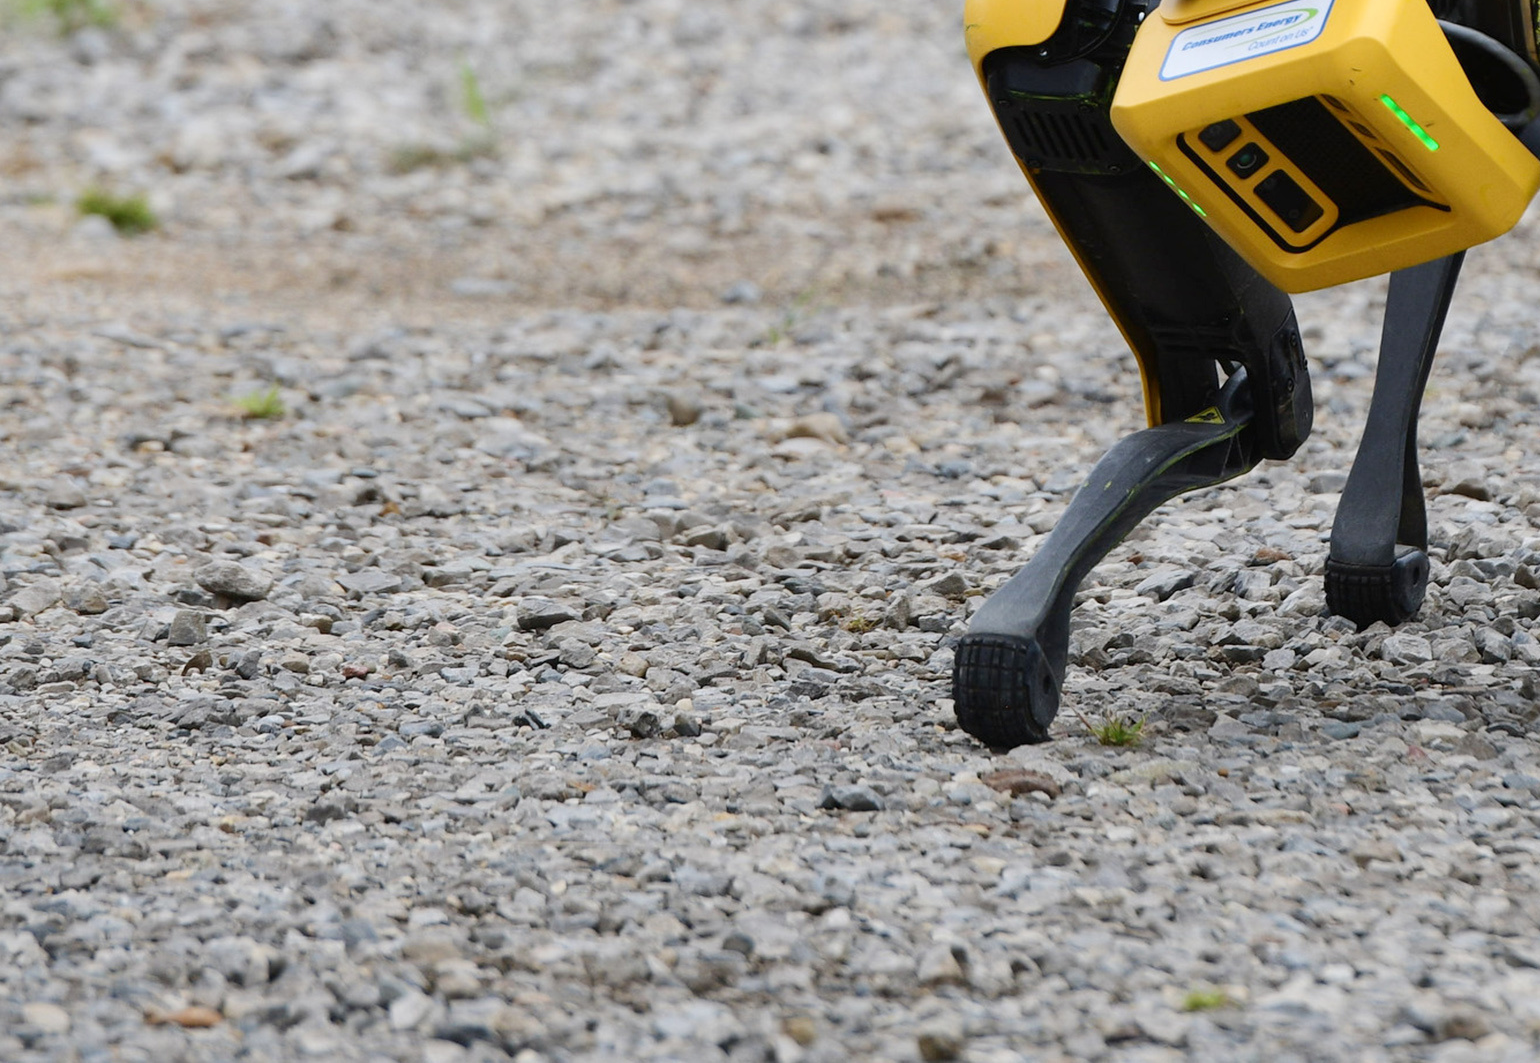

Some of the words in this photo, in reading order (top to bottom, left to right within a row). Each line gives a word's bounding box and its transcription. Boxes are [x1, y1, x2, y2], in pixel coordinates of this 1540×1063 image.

[1182, 27, 1255, 51] Consumers
[1256, 13, 1303, 32] Energy
[1248, 35, 1280, 51] Count
[1279, 33, 1294, 43] on
